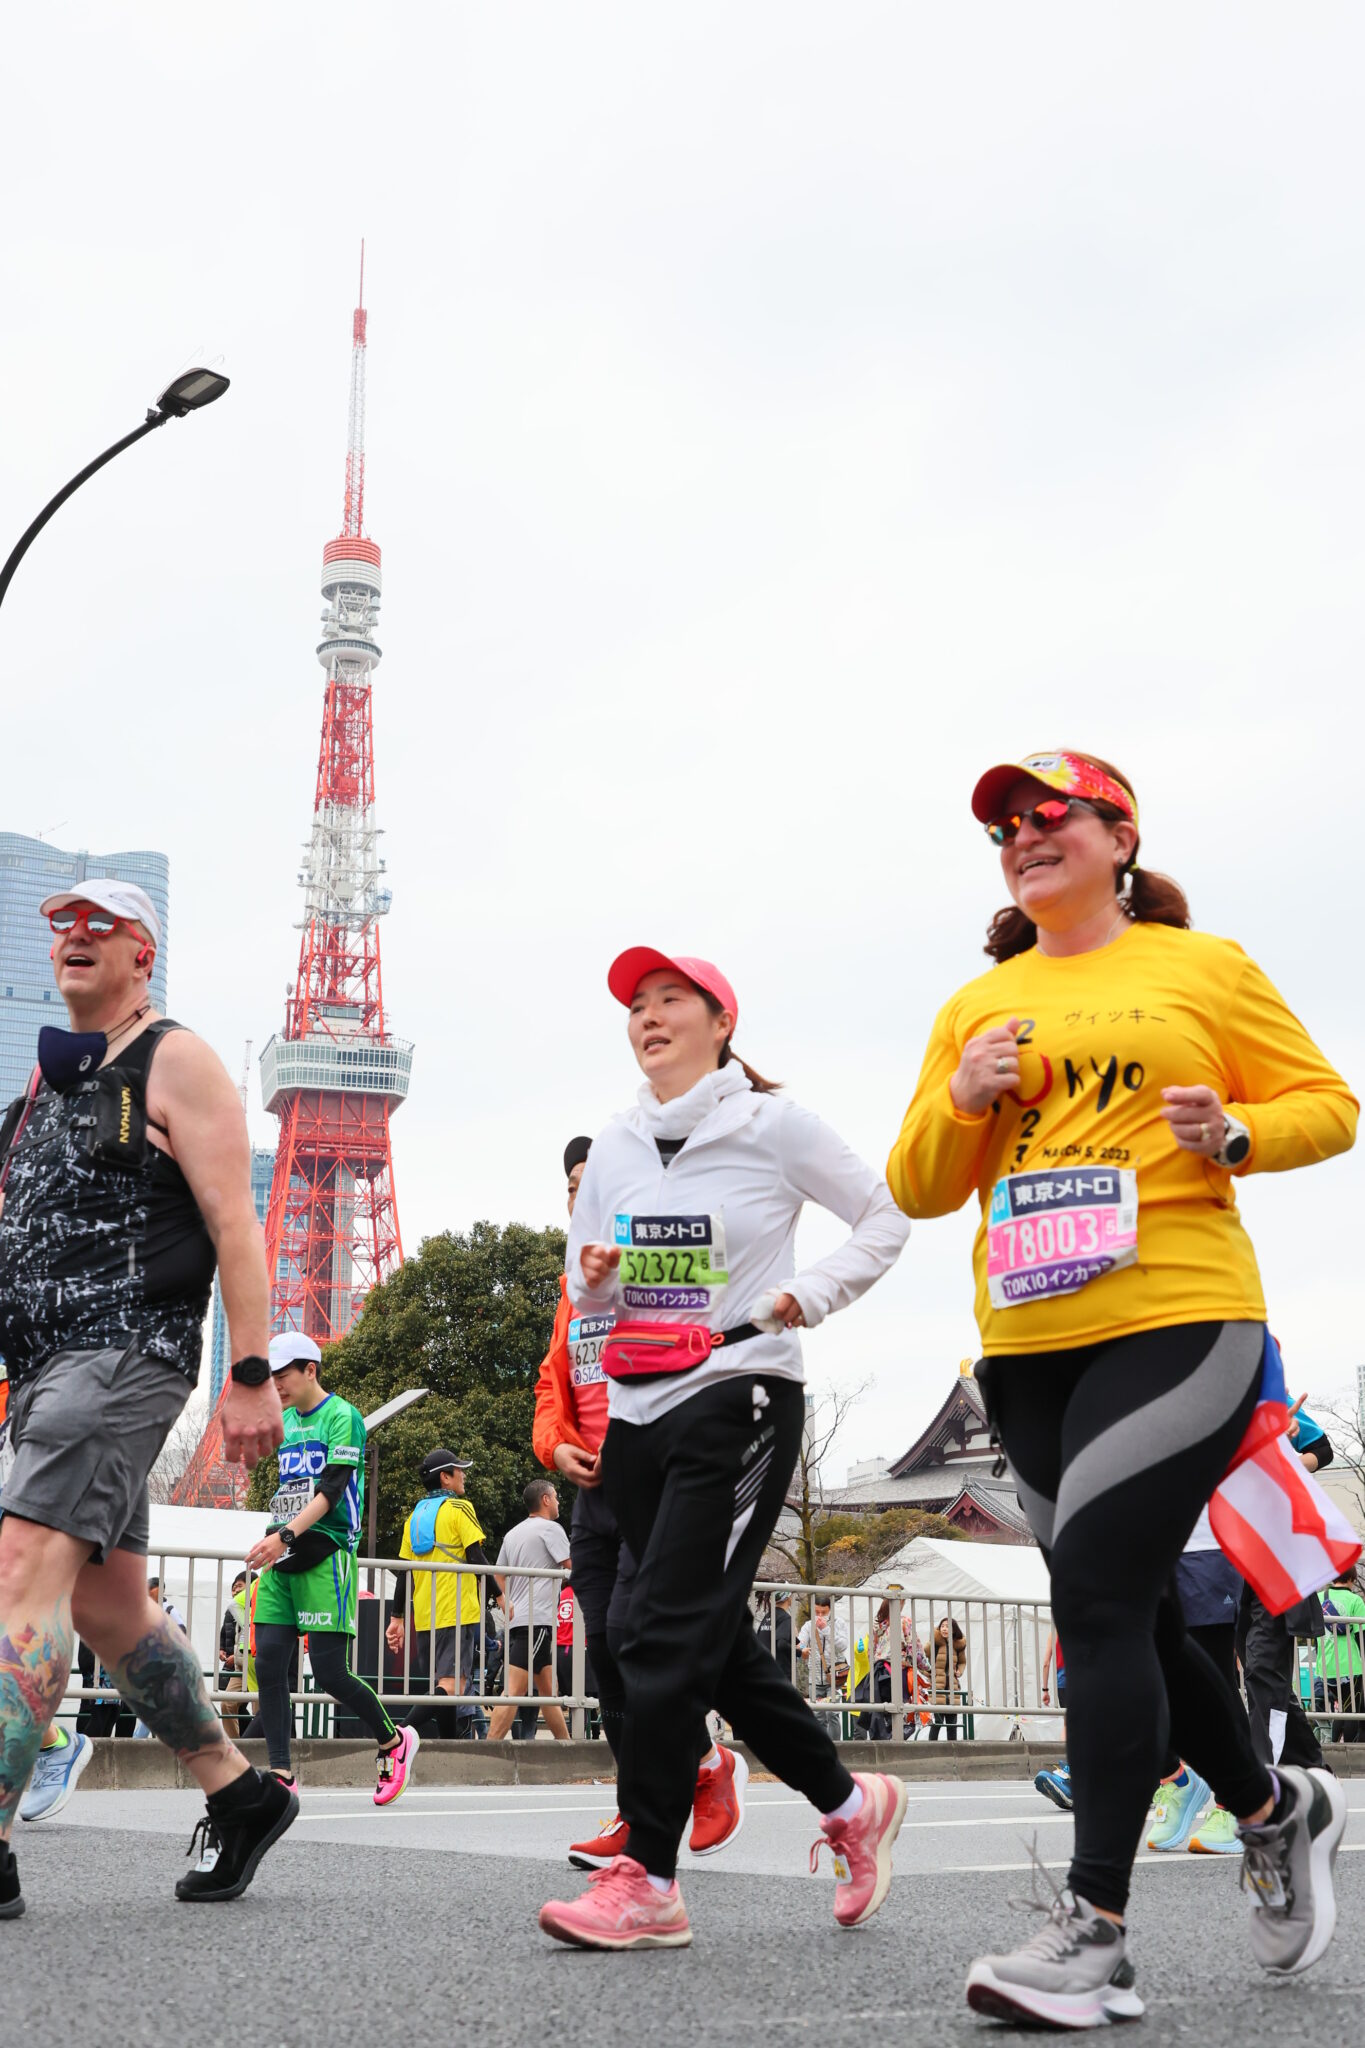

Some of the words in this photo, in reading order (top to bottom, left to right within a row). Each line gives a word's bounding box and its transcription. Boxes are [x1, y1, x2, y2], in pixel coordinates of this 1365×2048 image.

[119, 1086, 131, 1143] NATHAN
[1100, 1147, 1130, 1161] 2023
[1014, 1176, 1113, 1206] 東京メトロ
[635, 1222, 706, 1240] 東京メトロ
[1003, 1212, 1099, 1267] 78003
[626, 1251, 696, 1283] 52322
[701, 1258, 710, 1270] 5
[581, 1320, 616, 1334] 東京メト
